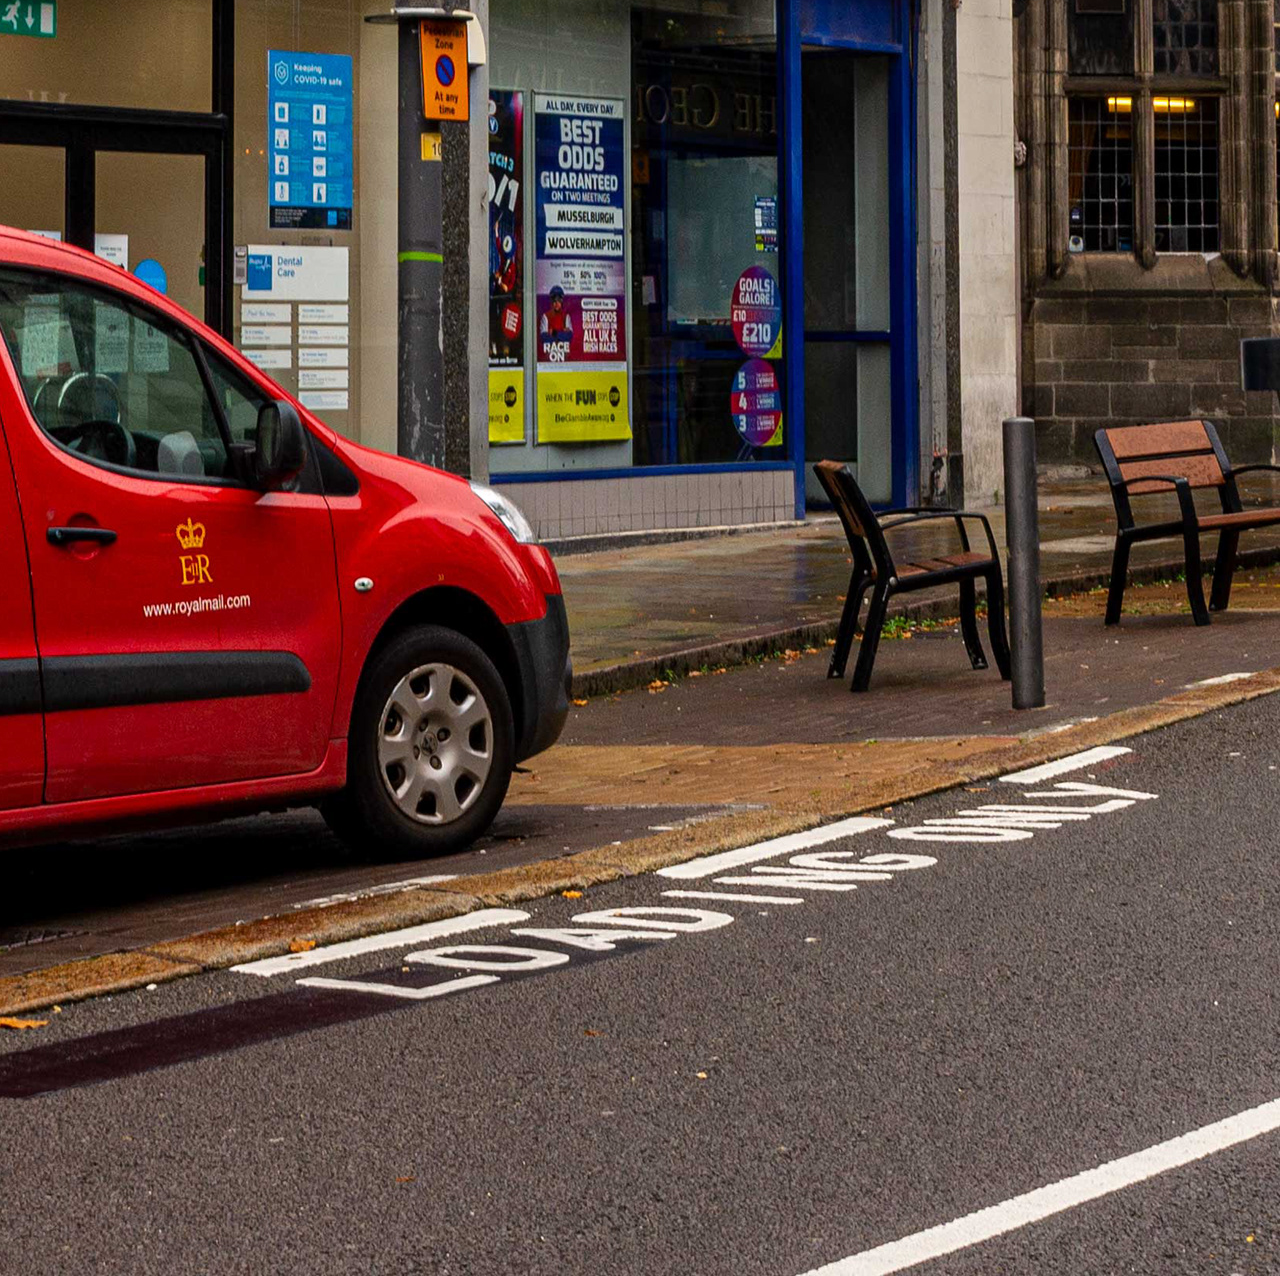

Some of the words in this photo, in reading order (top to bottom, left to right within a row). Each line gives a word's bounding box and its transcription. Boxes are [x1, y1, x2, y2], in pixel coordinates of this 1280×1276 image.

[435, 38, 453, 51] Zone
[294, 63, 323, 75] Keeping
[294, 75, 327, 86] COVID-19
[434, 91, 444, 102] At
[445, 93, 459, 104] any
[439, 105, 456, 115] time
[546, 100, 559, 111] ALL
[560, 101, 576, 114] DAY,
[577, 103, 600, 114] EVERY
[600, 105, 614, 115] DAY
[560, 118, 604, 144] BEST
[489, 152, 508, 169] TCH
[558, 145, 605, 172] ODDS
[540, 171, 619, 192] GUARANTEED
[551, 190, 564, 201] ON
[565, 191, 581, 202] TWO
[582, 193, 611, 204] MEETINGS
[557, 209, 615, 225] MUSSELBURGH
[548, 236, 621, 251] WOLVERHAMPTON
[277, 256, 303, 267] Dental
[277, 267, 296, 278] Care
[739, 277, 771, 293] GOALS
[739, 292, 771, 306] GALORE
[582, 311, 598, 322] BEST
[599, 311, 617, 322] ODDS
[733, 309, 747, 322] £10
[584, 329, 597, 342] ALL
[599, 330, 610, 343] UK
[742, 322, 771, 343] £210
[543, 341, 570, 353] RACE
[549, 352, 565, 362] ON
[738, 371, 746, 389] 5
[575, 389, 597, 406] FUN
[738, 392, 748, 411] 4
[738, 414, 747, 433] 3
[143, 594, 251, 618] www.royalmail.com
[295, 850, 939, 1000] LOADING
[886, 780, 1160, 843] ONLY
